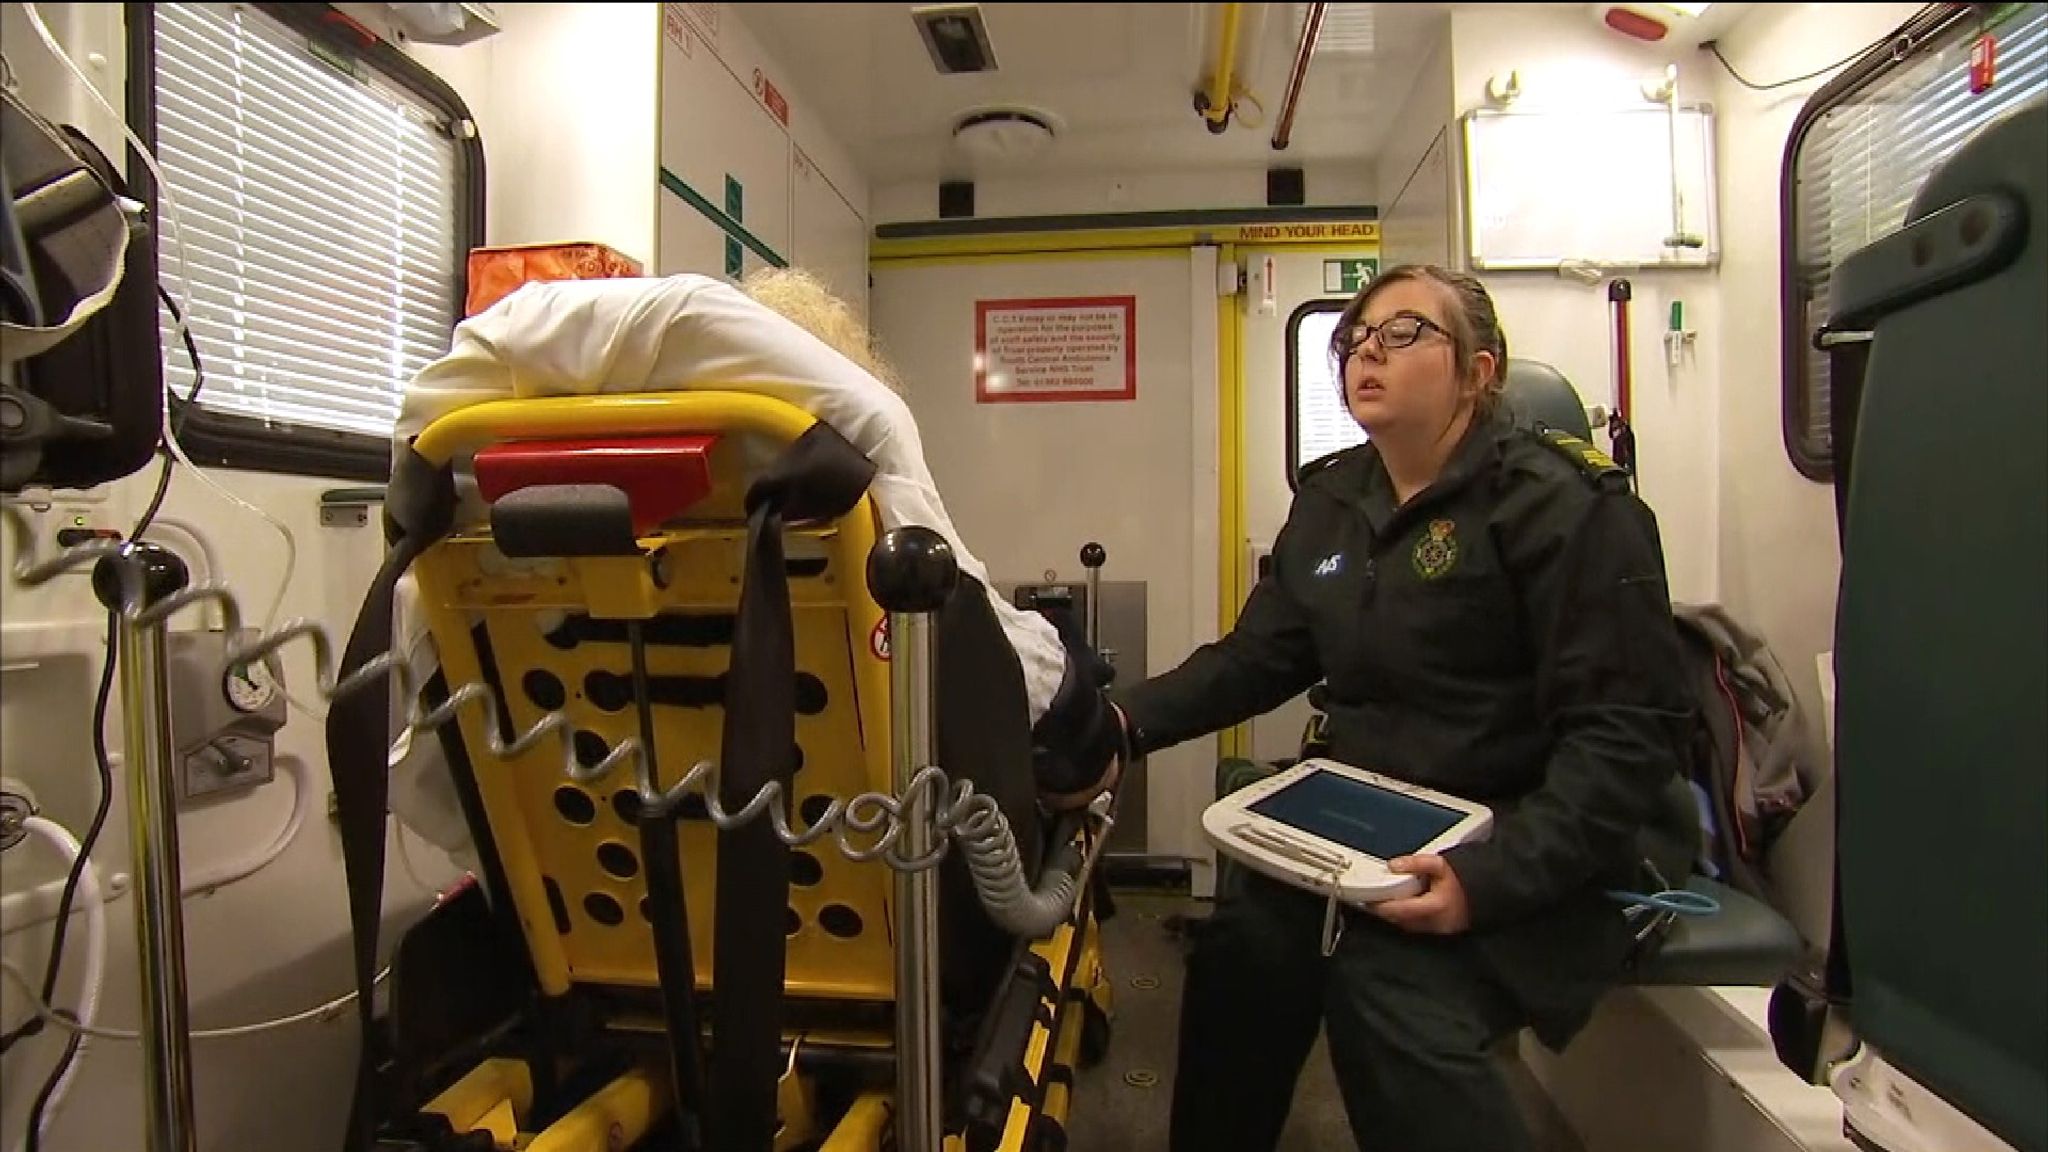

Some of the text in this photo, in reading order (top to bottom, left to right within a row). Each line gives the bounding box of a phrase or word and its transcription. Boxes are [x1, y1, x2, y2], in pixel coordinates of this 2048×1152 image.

[1240, 224, 1374, 238] MIND YOUR HEAD
[1023, 335, 1047, 343] safety
[1087, 333, 1120, 341] security
[1015, 366, 1046, 374] Service
[1050, 365, 1068, 373] NHS
